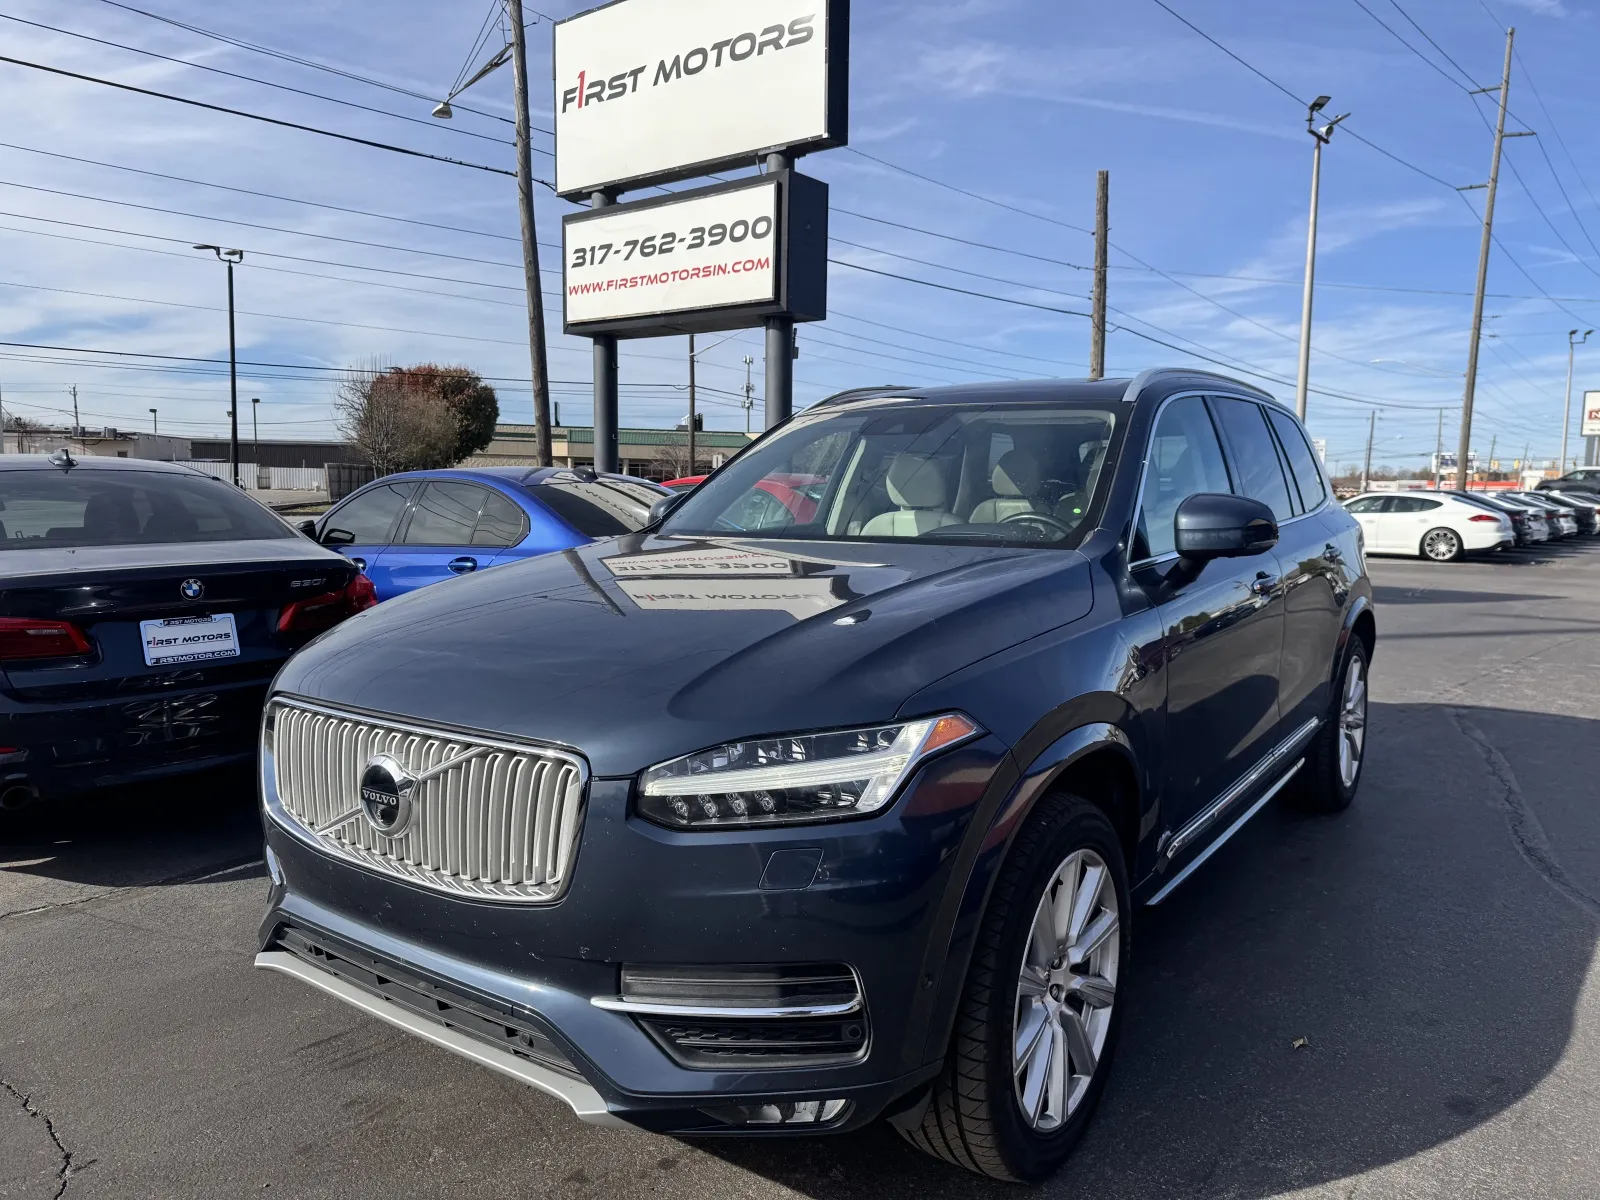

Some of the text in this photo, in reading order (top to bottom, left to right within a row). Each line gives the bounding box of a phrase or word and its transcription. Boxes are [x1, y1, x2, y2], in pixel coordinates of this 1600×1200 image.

[653, 14, 816, 87] MOTORS
[571, 216, 773, 269] 317-762-3900
[569, 257, 770, 297] WWW.FIRSTMOTORSIN.COM
[182, 632, 231, 643] MOTORS
[362, 789, 397, 805] VOLVO
